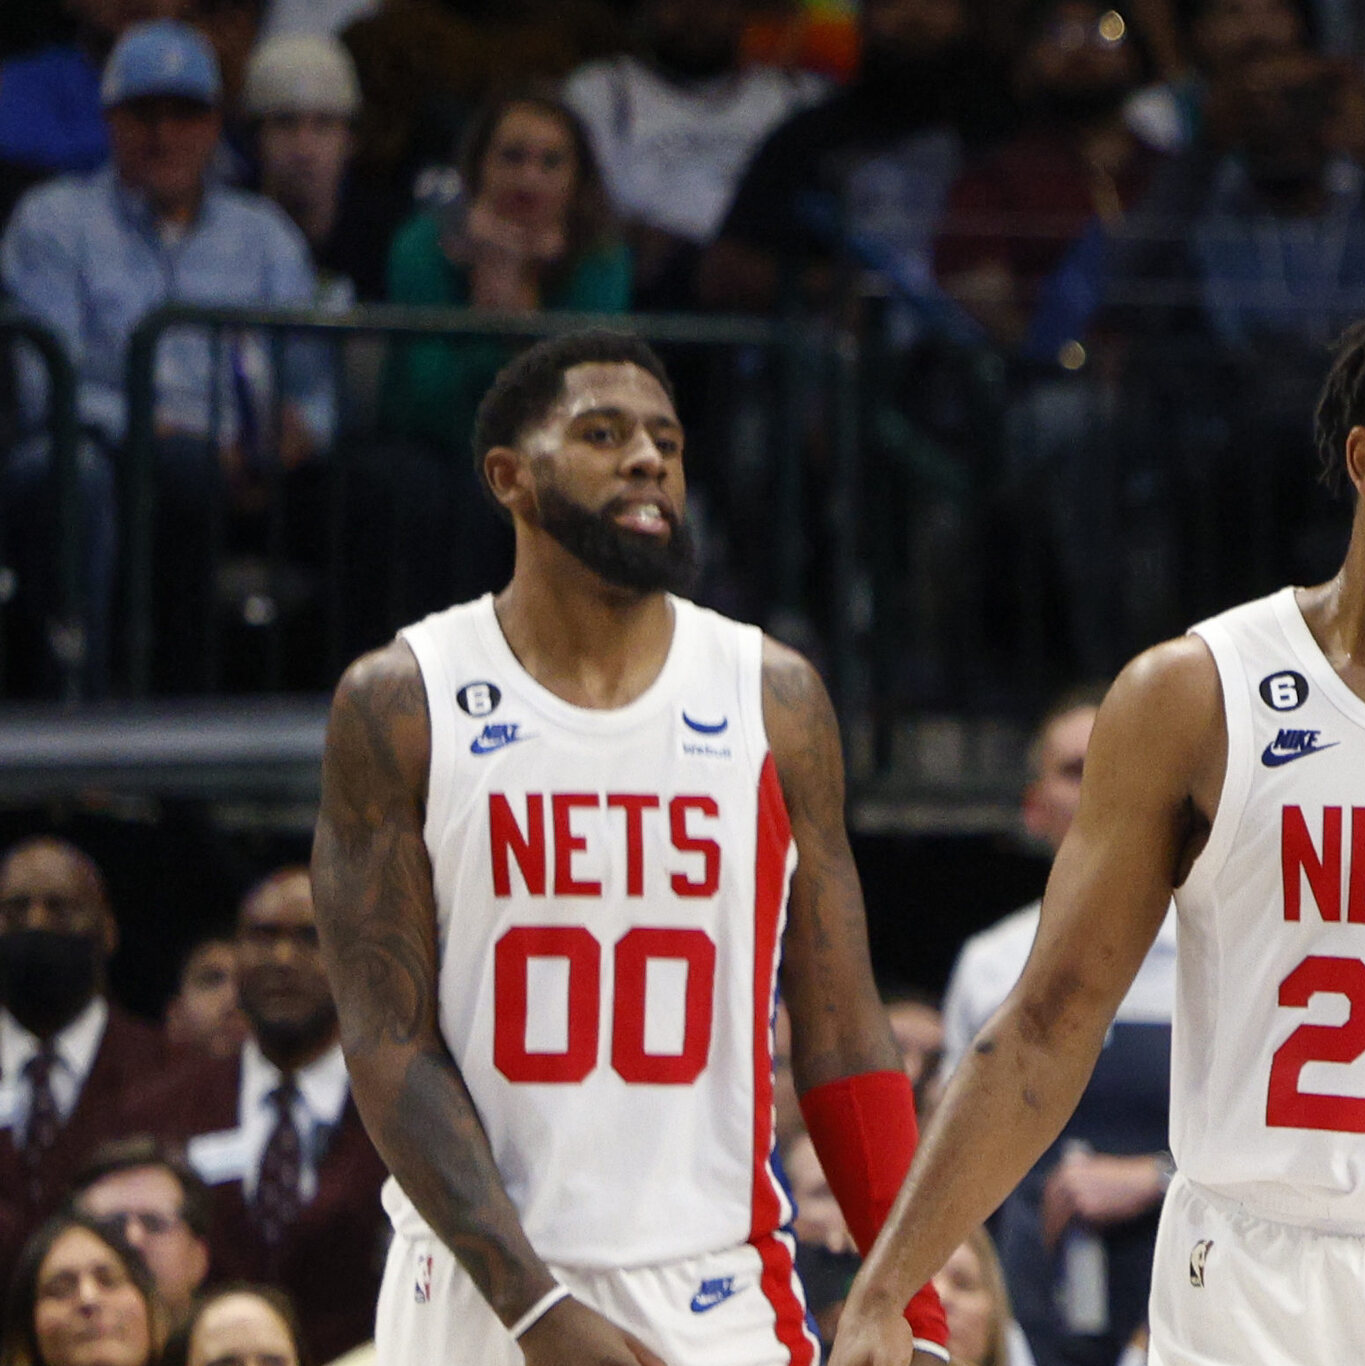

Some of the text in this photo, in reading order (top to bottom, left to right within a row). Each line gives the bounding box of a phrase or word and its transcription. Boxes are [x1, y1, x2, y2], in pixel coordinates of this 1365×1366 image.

[1270, 674, 1299, 709] 6
[1273, 728, 1321, 752] NIKE
[488, 793, 721, 898] NETS
[493, 926, 716, 1085] 00
